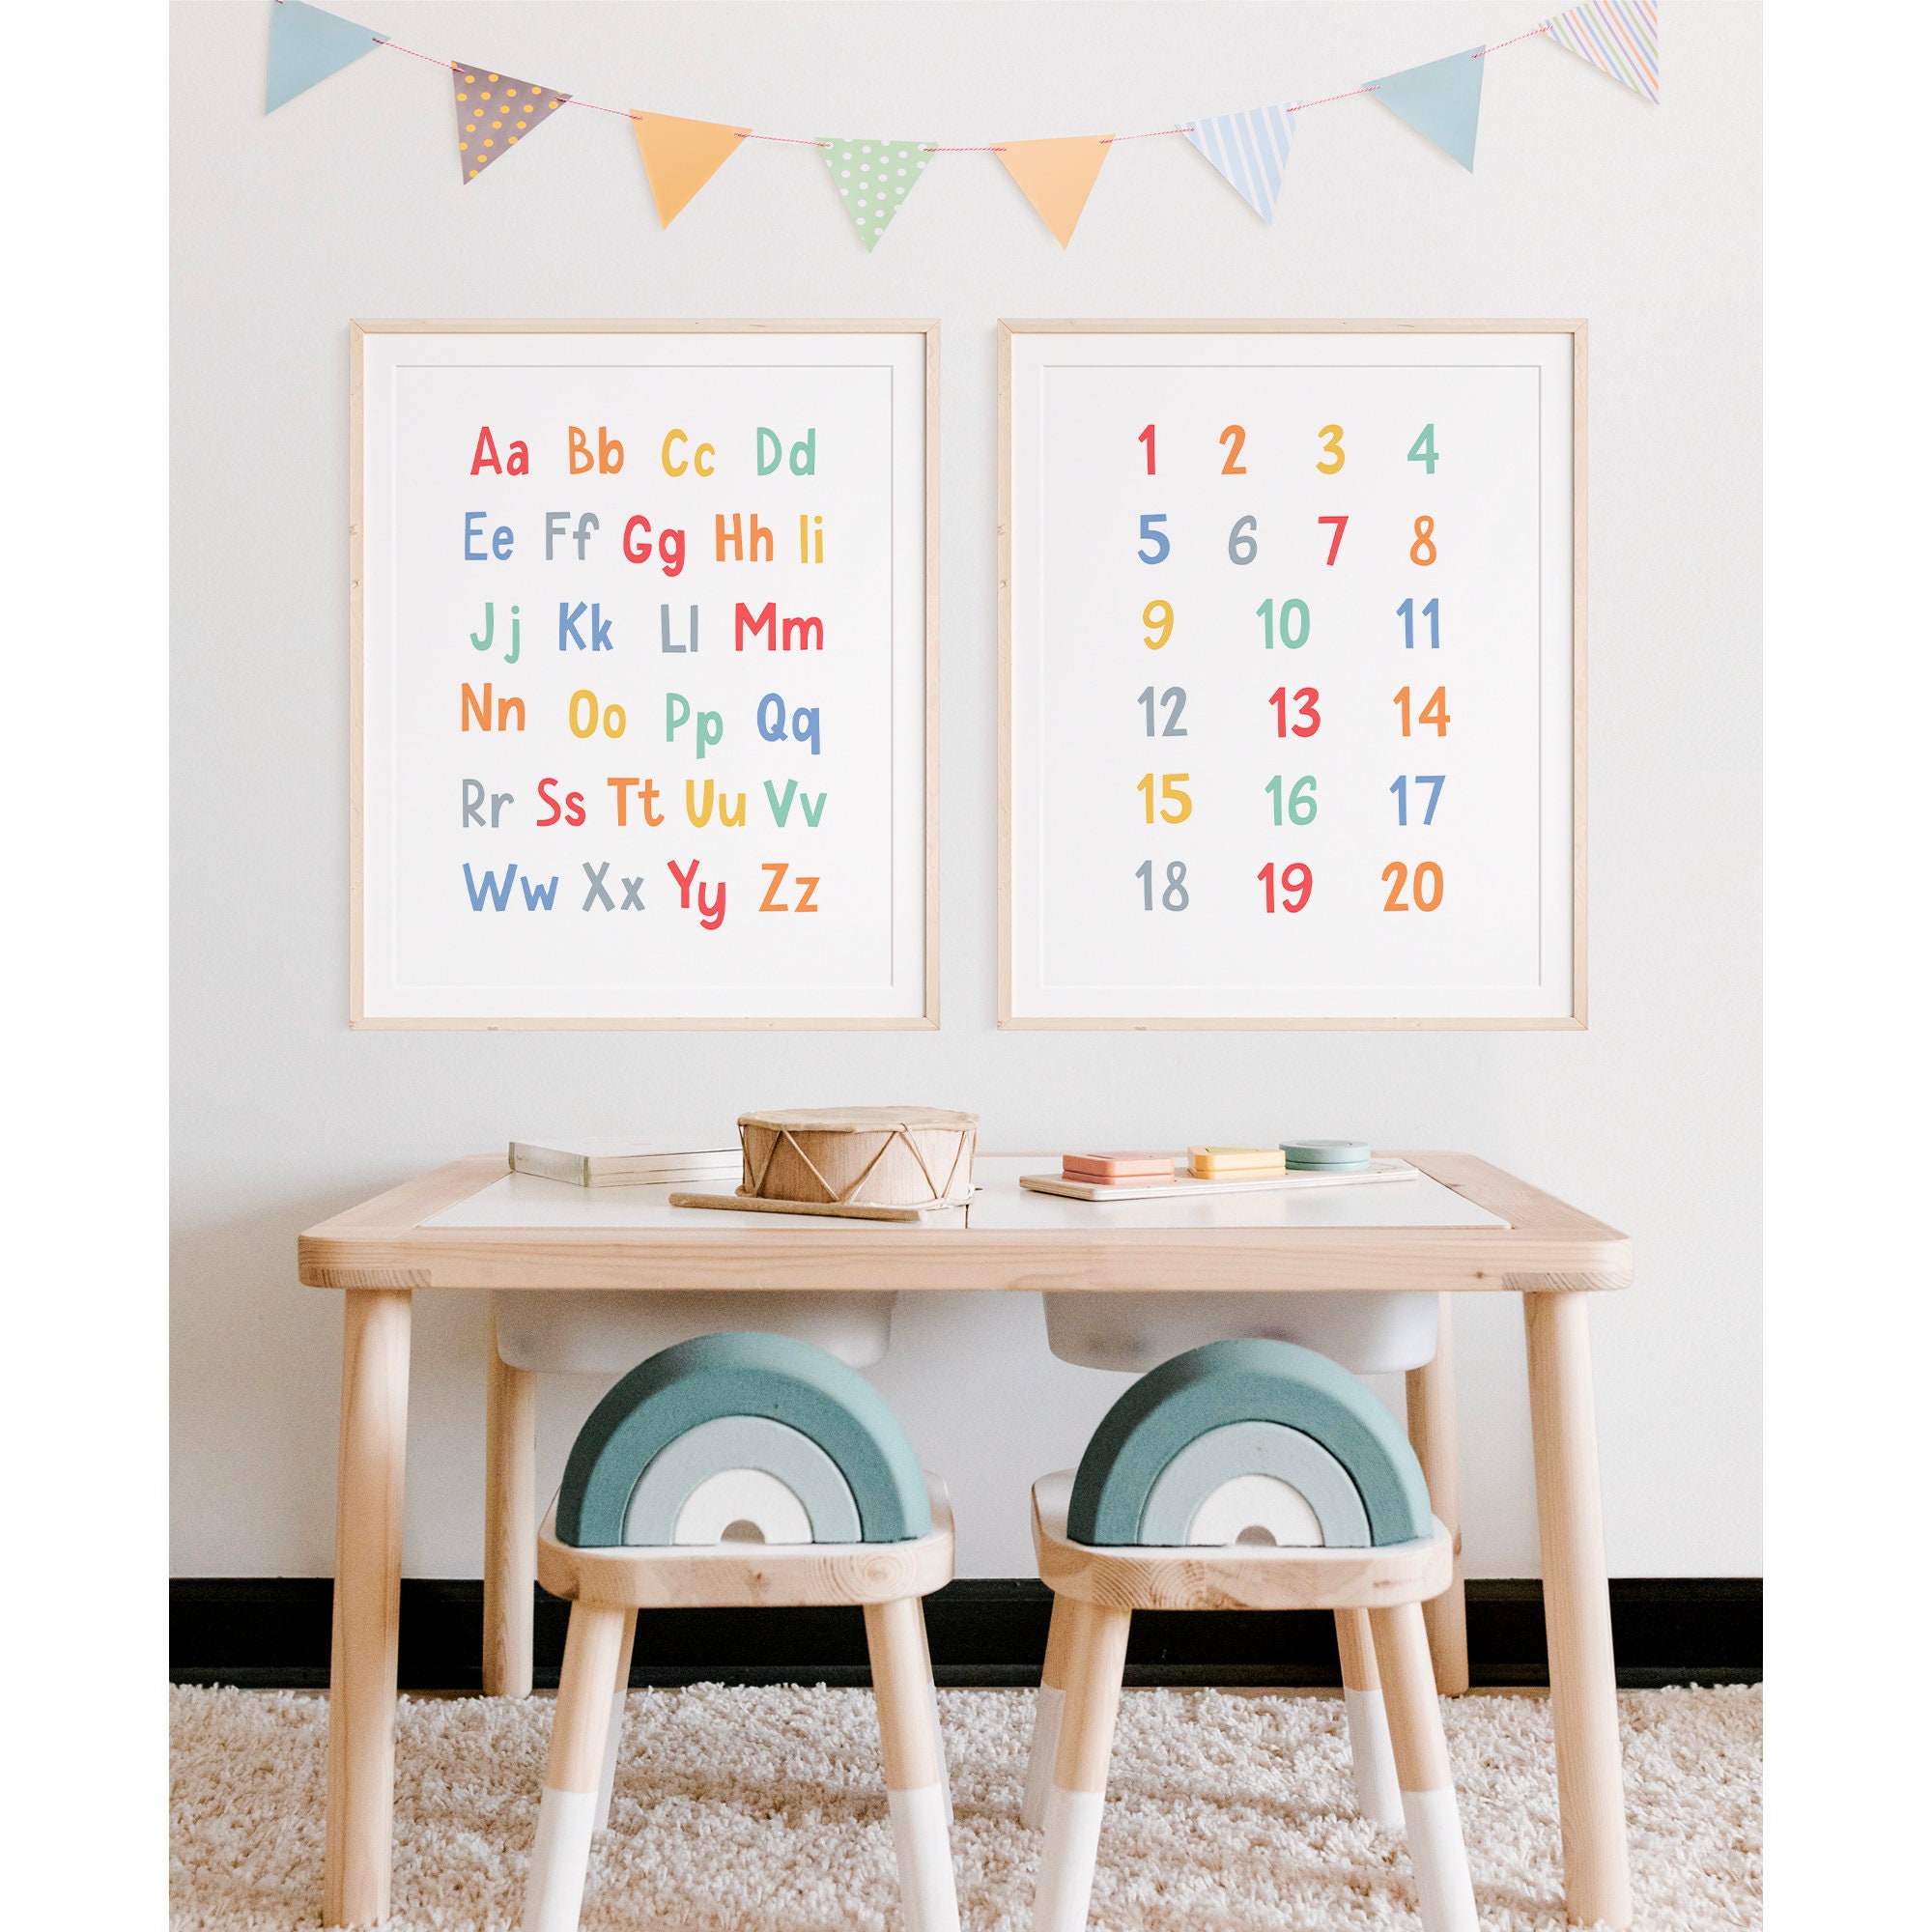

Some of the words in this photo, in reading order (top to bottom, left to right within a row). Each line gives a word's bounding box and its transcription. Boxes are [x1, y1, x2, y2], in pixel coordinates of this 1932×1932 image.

[469, 425, 529, 477] Aa
[567, 425, 625, 475] Bb
[661, 427, 716, 478] Cc
[756, 426, 816, 477] Dd
[1137, 423, 1156, 476] 1
[1218, 423, 1248, 476] 2
[1315, 423, 1346, 476] 3
[1406, 423, 1440, 475] 4
[464, 511, 515, 561] Ee
[545, 511, 600, 561] Ff
[622, 514, 686, 579] Gg
[715, 512, 775, 563] Hh
[1137, 513, 1171, 566] 5
[1228, 514, 1258, 566] 6
[1317, 515, 1350, 567] 7
[1409, 514, 1437, 567] 8
[469, 602, 521, 665] Jj
[558, 601, 614, 652] Kk
[734, 601, 824, 652] Mm
[1142, 598, 1176, 651] 9
[1255, 598, 1311, 650] 10
[1395, 597, 1440, 649] 11
[461, 681, 526, 733] Nn
[568, 688, 627, 740] Oo
[666, 692, 724, 760] Pp
[756, 692, 821, 755] Qq
[1137, 686, 1188, 737] 12
[1267, 686, 1321, 739] 13
[1392, 685, 1452, 738] 14
[462, 778, 515, 829] Rr
[535, 777, 586, 828] Ss
[606, 777, 666, 828] Tt
[685, 778, 747, 829] Uu
[762, 778, 828, 828] Vv
[1135, 772, 1193, 825] 15
[1264, 775, 1318, 827] 16
[1389, 774, 1446, 827] 17
[462, 862, 560, 913] Ww
[582, 861, 646, 913] Xx
[666, 858, 726, 931] Yy
[757, 862, 821, 913] Zz
[1134, 860, 1190, 912] 18
[1256, 862, 1314, 914] 19
[1380, 860, 1444, 913] 20
